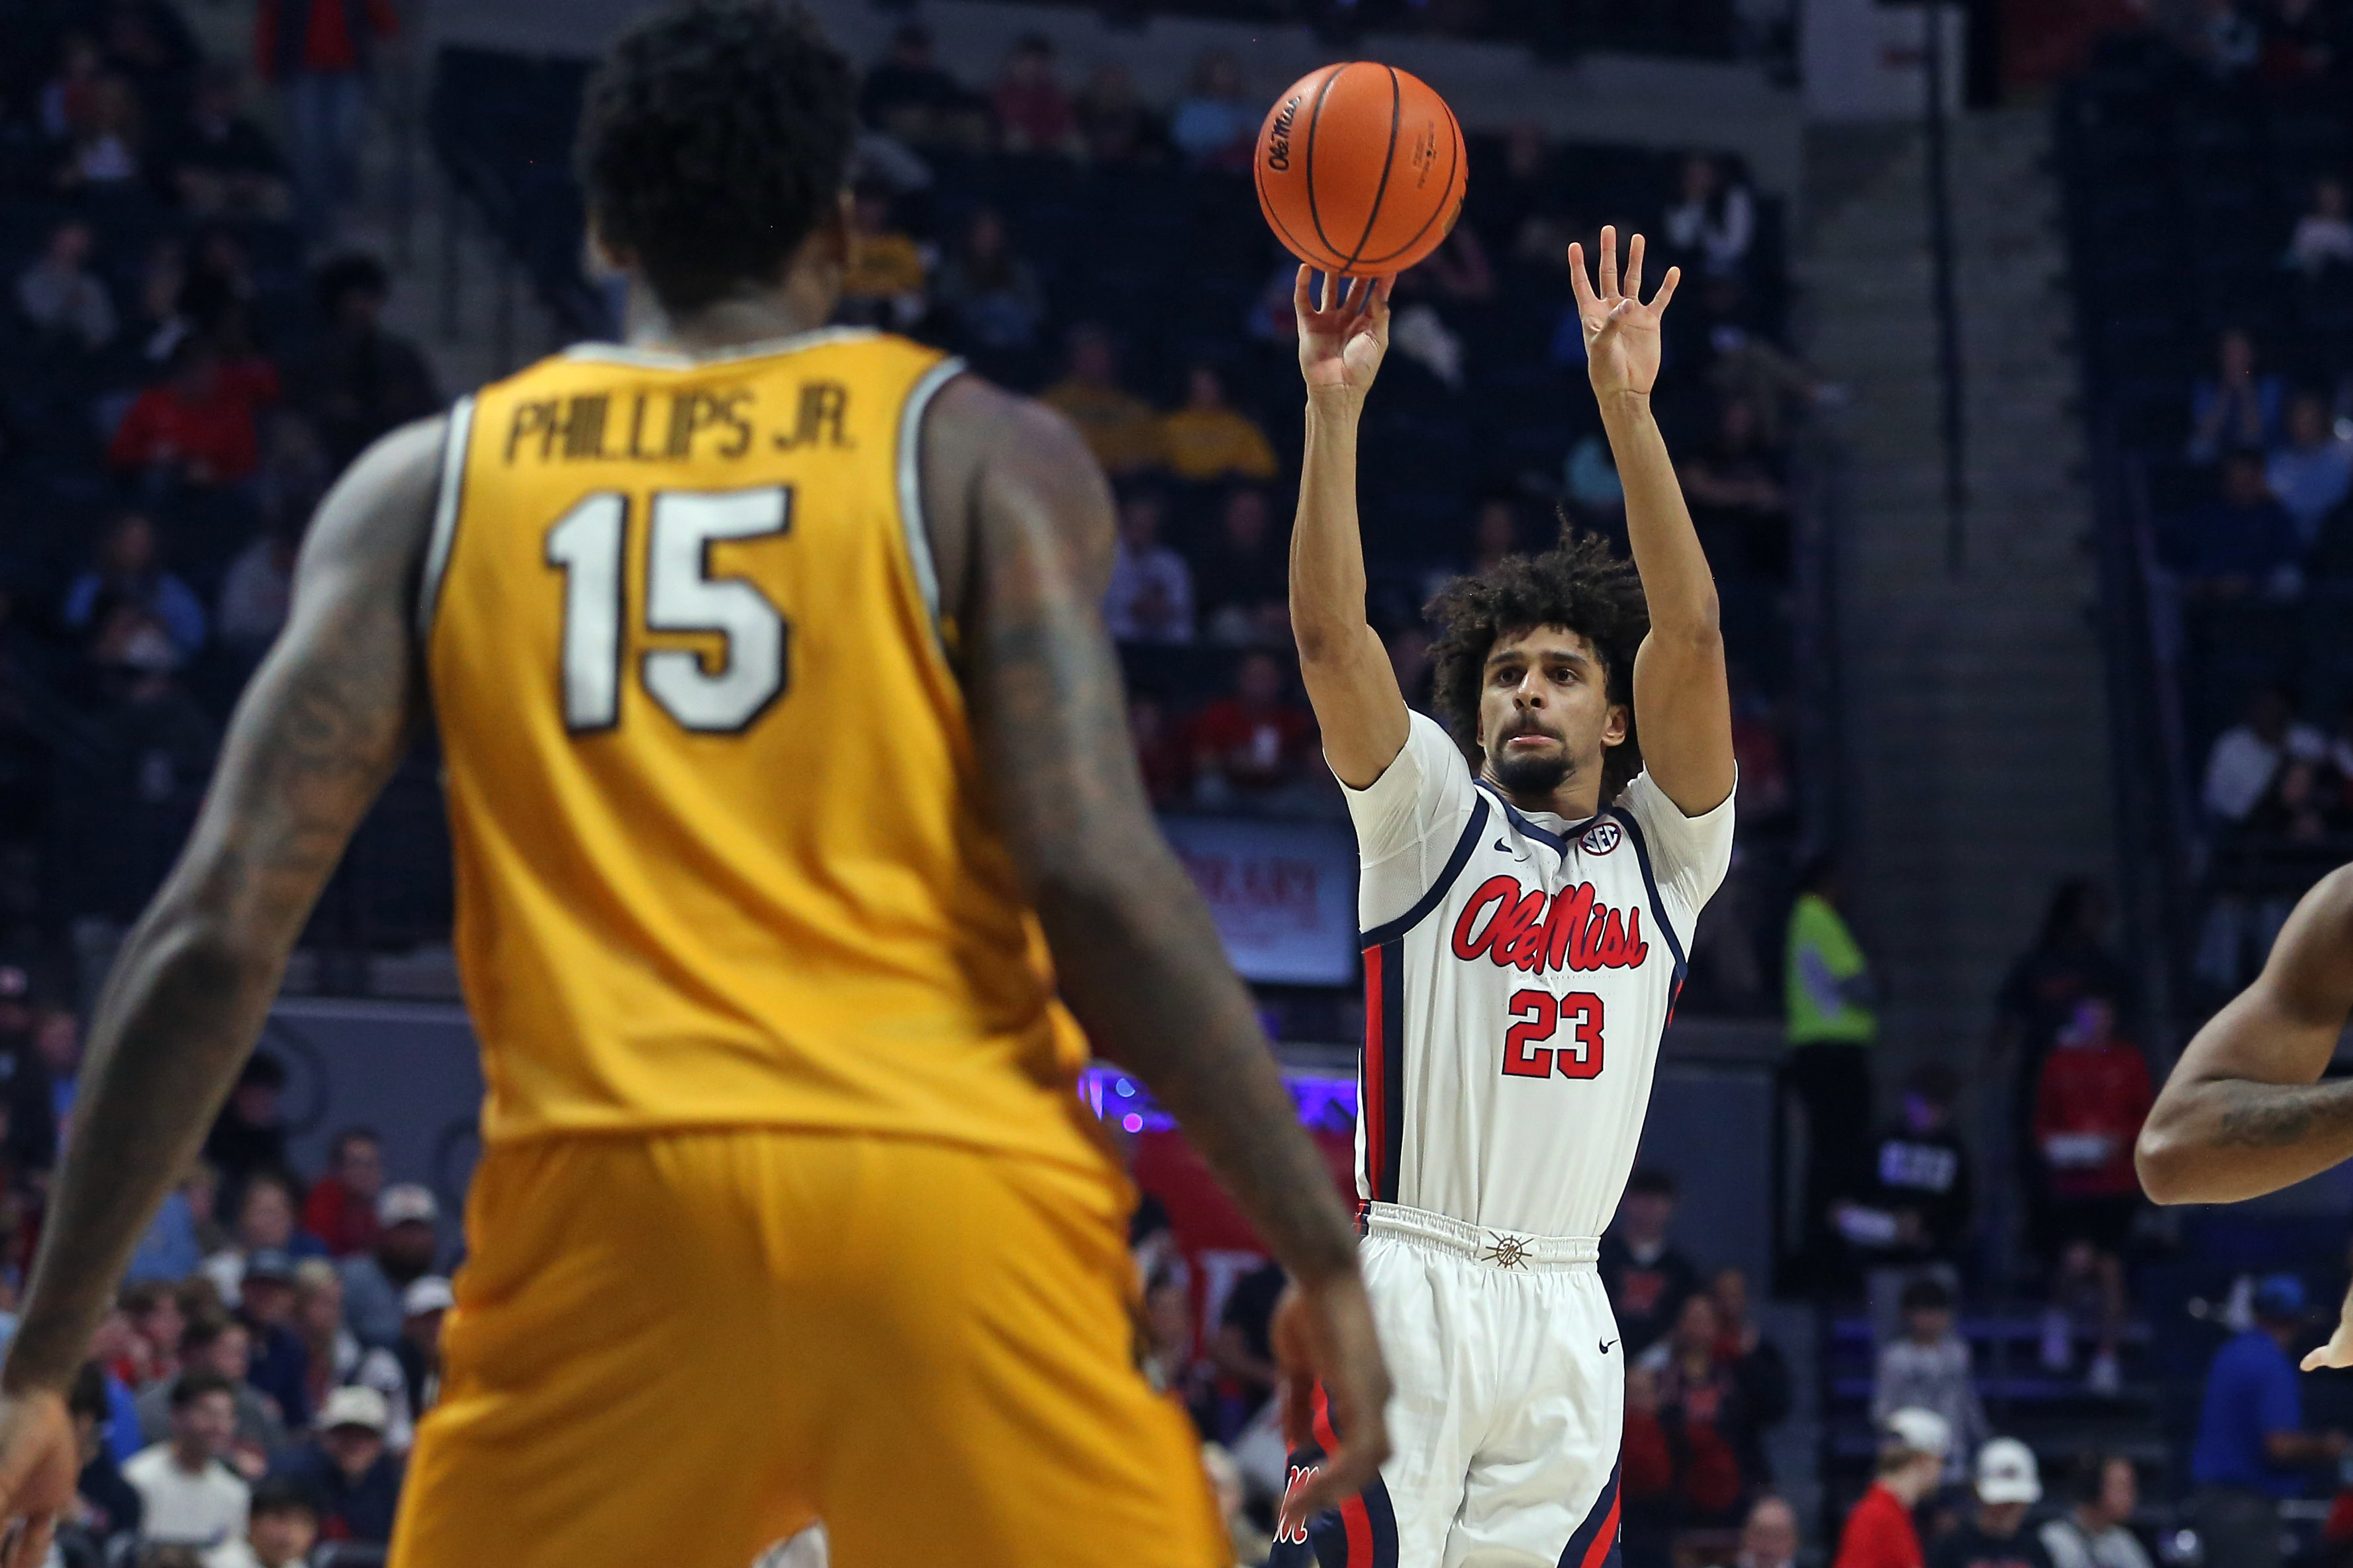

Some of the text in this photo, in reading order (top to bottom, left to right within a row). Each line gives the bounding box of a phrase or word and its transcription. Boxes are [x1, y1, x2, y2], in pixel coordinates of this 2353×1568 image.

[1269, 140, 1290, 171] Ole
[503, 381, 855, 463] PHILLIPS JR.
[543, 483, 793, 738] 15
[1582, 824, 1619, 854] SEC
[1451, 874, 1649, 975] Ole Miss
[1502, 988, 1604, 1080] 23
